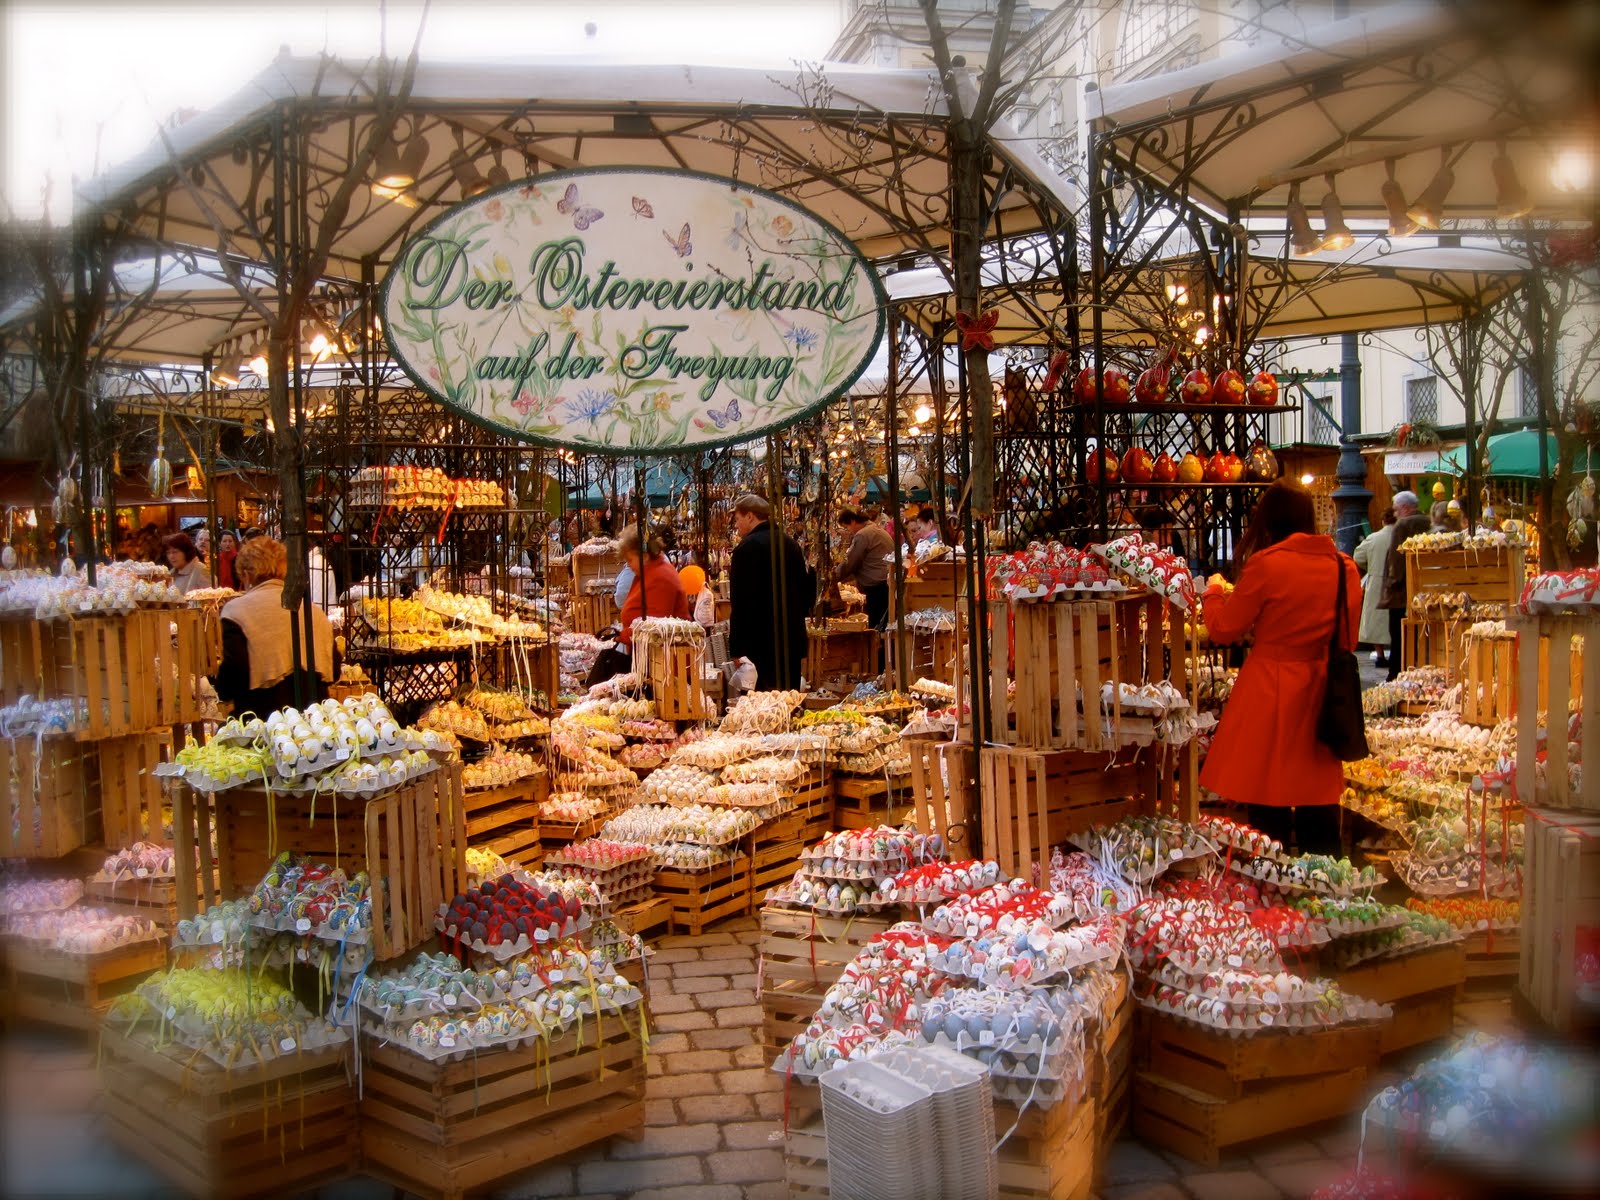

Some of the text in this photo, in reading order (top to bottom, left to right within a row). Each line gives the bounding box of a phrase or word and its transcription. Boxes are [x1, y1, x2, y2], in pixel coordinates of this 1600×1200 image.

[403, 236, 858, 312] Der Ostereierstand
[476, 324, 794, 401] auf der Freyung
